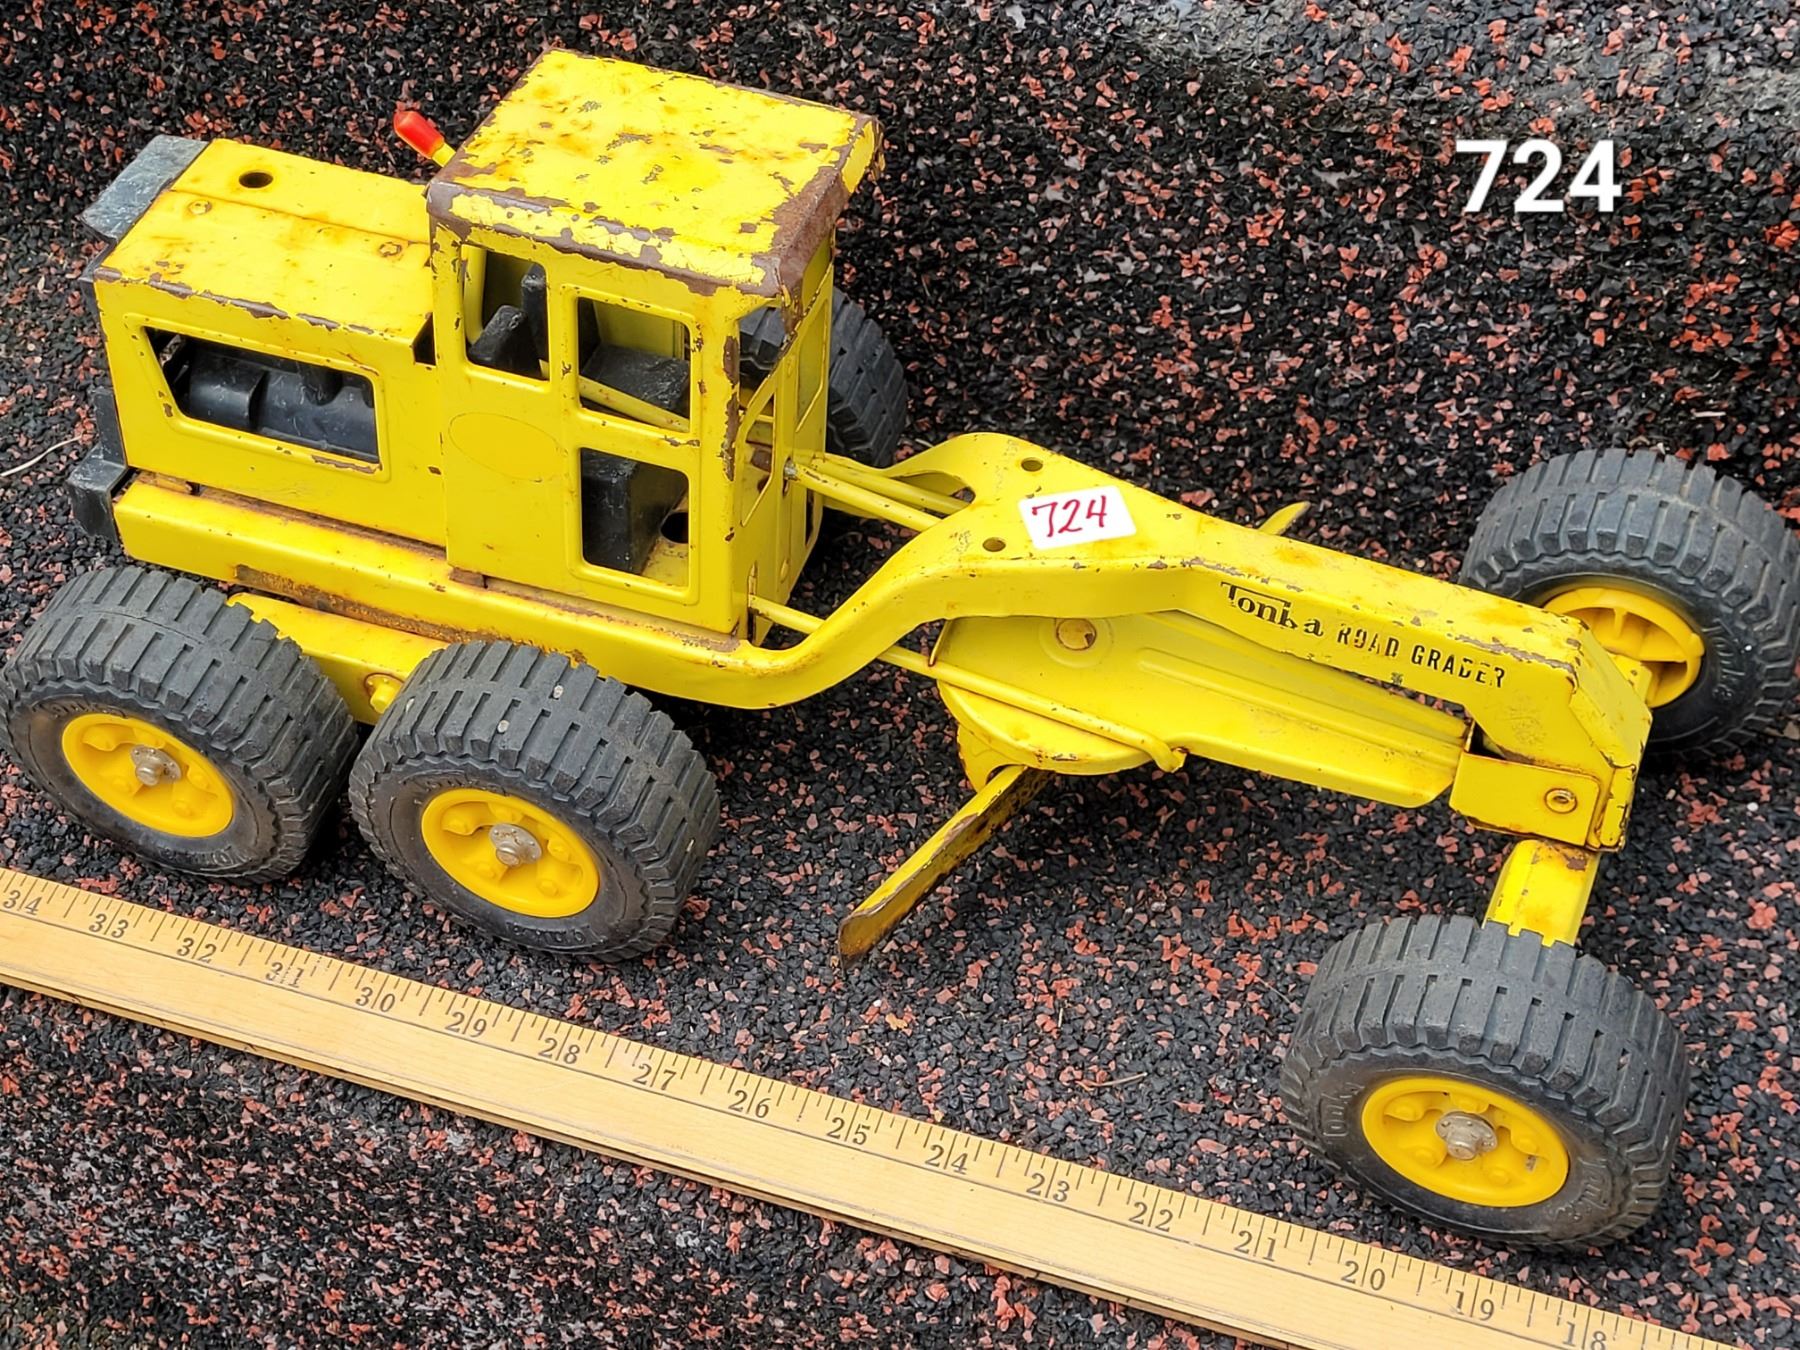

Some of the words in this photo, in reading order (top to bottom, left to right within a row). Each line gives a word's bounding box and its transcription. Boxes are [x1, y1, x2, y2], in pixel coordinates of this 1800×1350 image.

[1031, 495, 1107, 537] 724
[1220, 581, 1324, 638] Tonka
[1336, 622, 1400, 658] ROAD
[1410, 644, 1506, 689] GRADER
[2, 889, 42, 916] 34
[88, 913, 129, 939] 33
[176, 937, 217, 964] 32
[265, 962, 305, 988] 31
[354, 987, 396, 1014] 30
[444, 1011, 487, 1039] 29
[538, 1037, 581, 1065] 28
[632, 1063, 677, 1091] 27
[728, 1089, 770, 1119] 26
[826, 1117, 869, 1146] 25
[924, 1144, 968, 1175] 24
[1027, 1172, 1071, 1203] 23
[1128, 1201, 1174, 1233] 22
[1234, 1230, 1278, 1262] 21
[1341, 1260, 1386, 1291] 20
[1454, 1289, 1495, 1322] 19
[1562, 1321, 1608, 1350] 18
